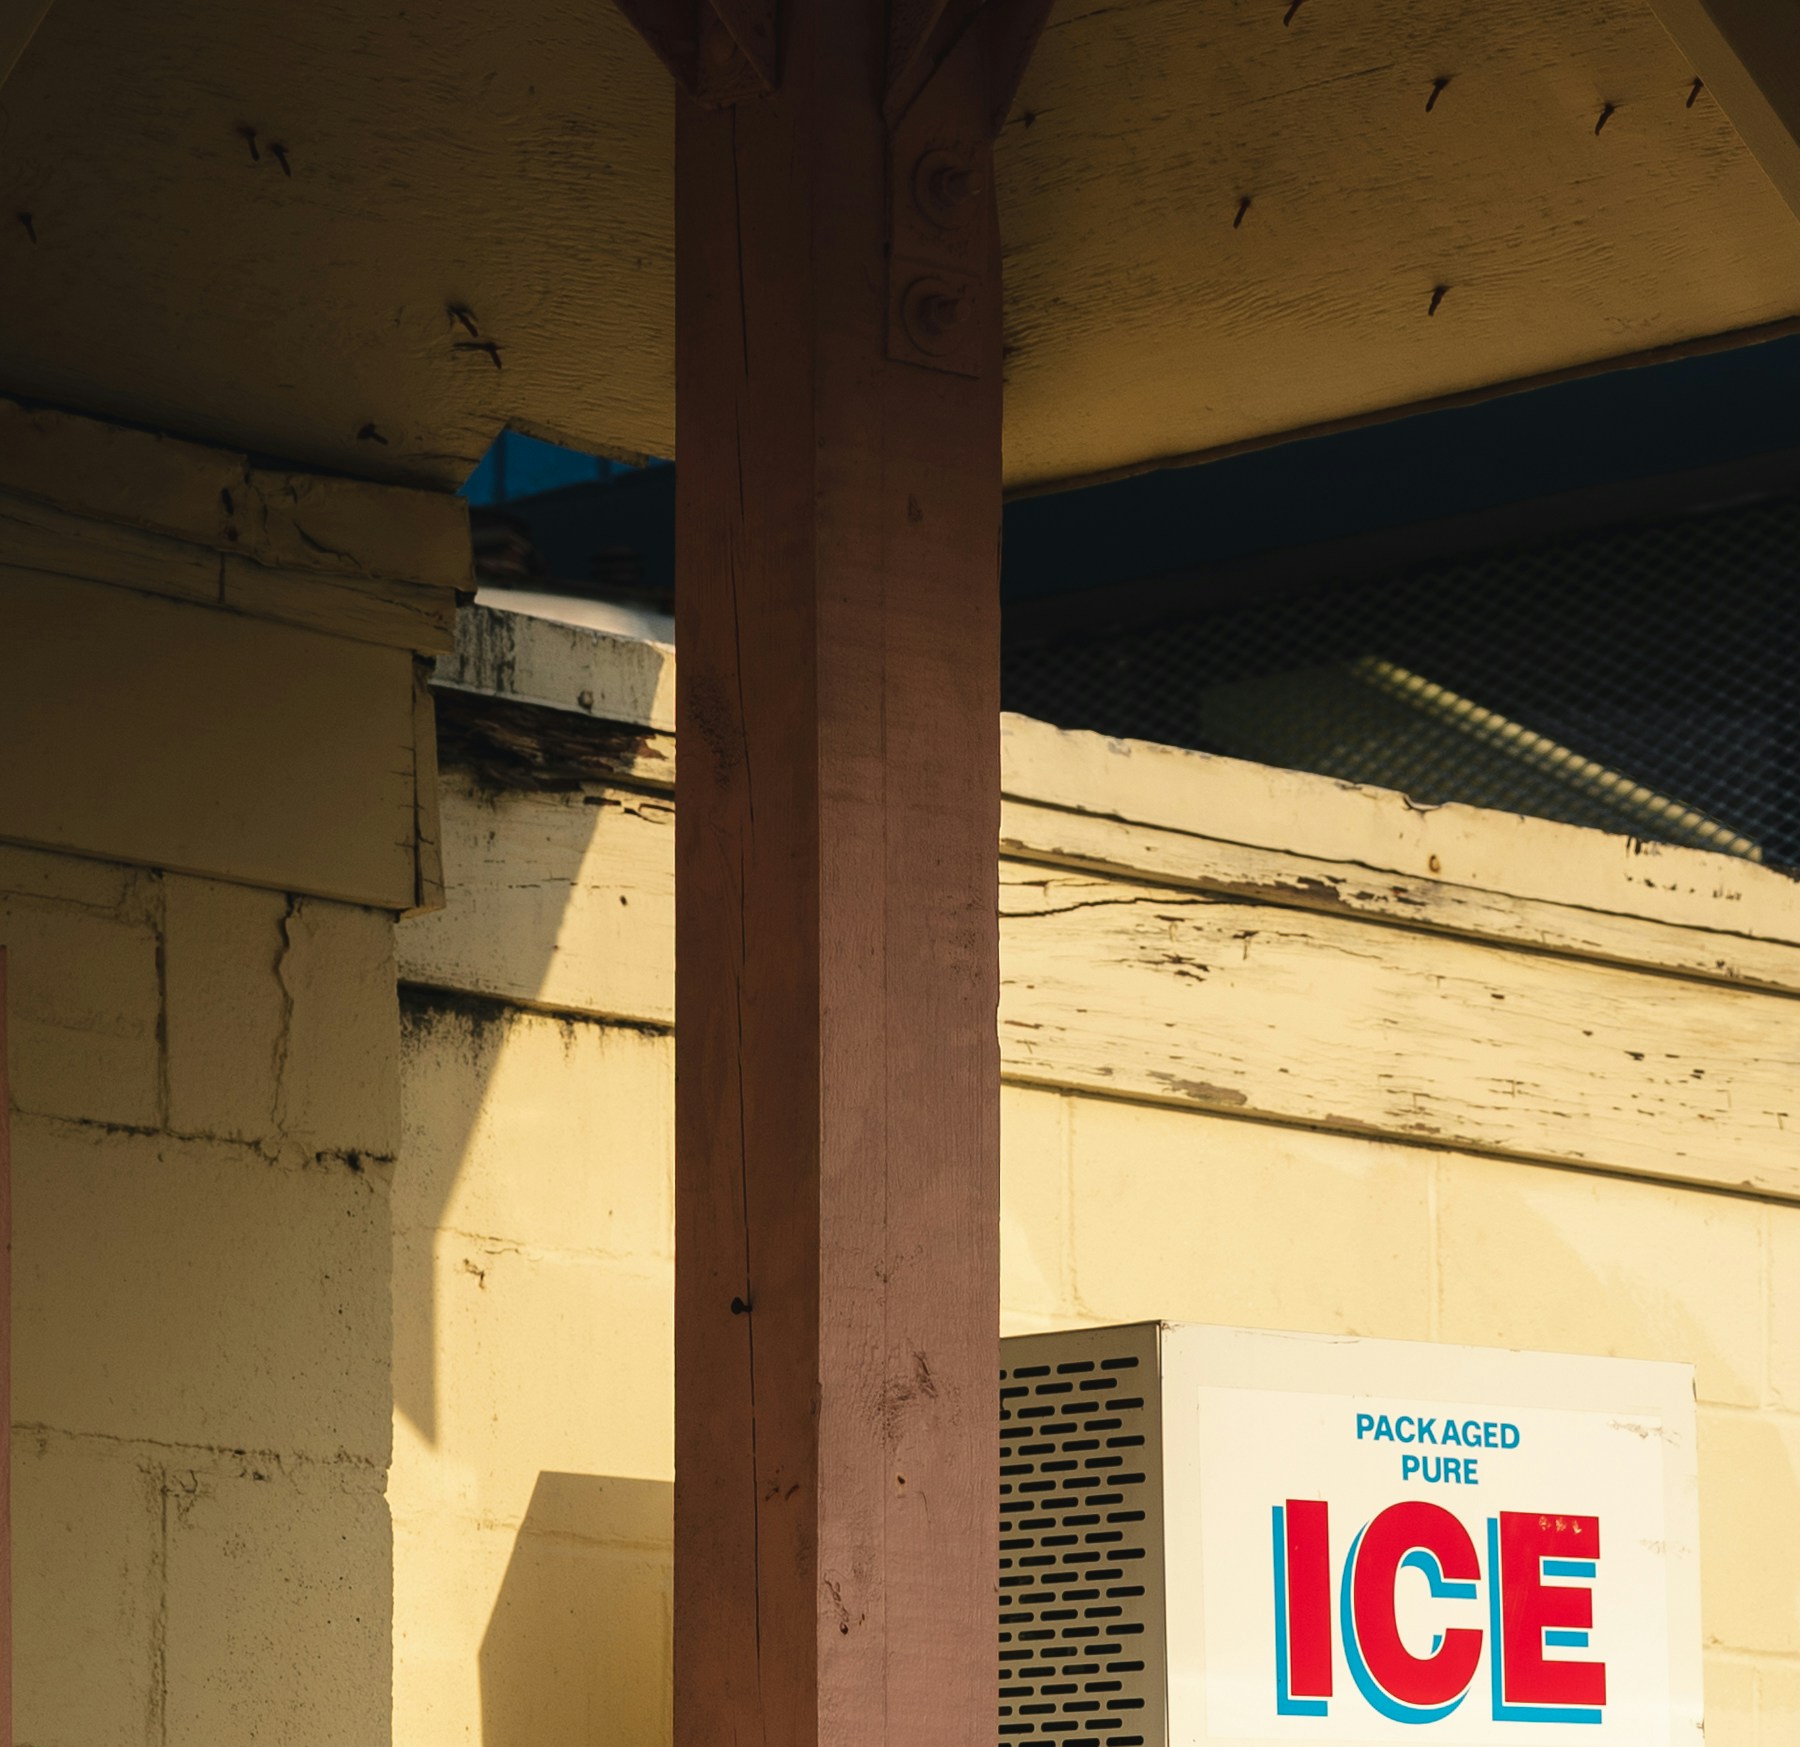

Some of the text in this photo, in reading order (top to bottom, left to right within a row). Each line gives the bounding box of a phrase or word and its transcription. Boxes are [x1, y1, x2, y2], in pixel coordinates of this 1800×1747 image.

[1356, 1413, 1521, 1450] PACKAGED
[1401, 1454, 1479, 1485] PURE
[1272, 1498, 1607, 1724] ICE
